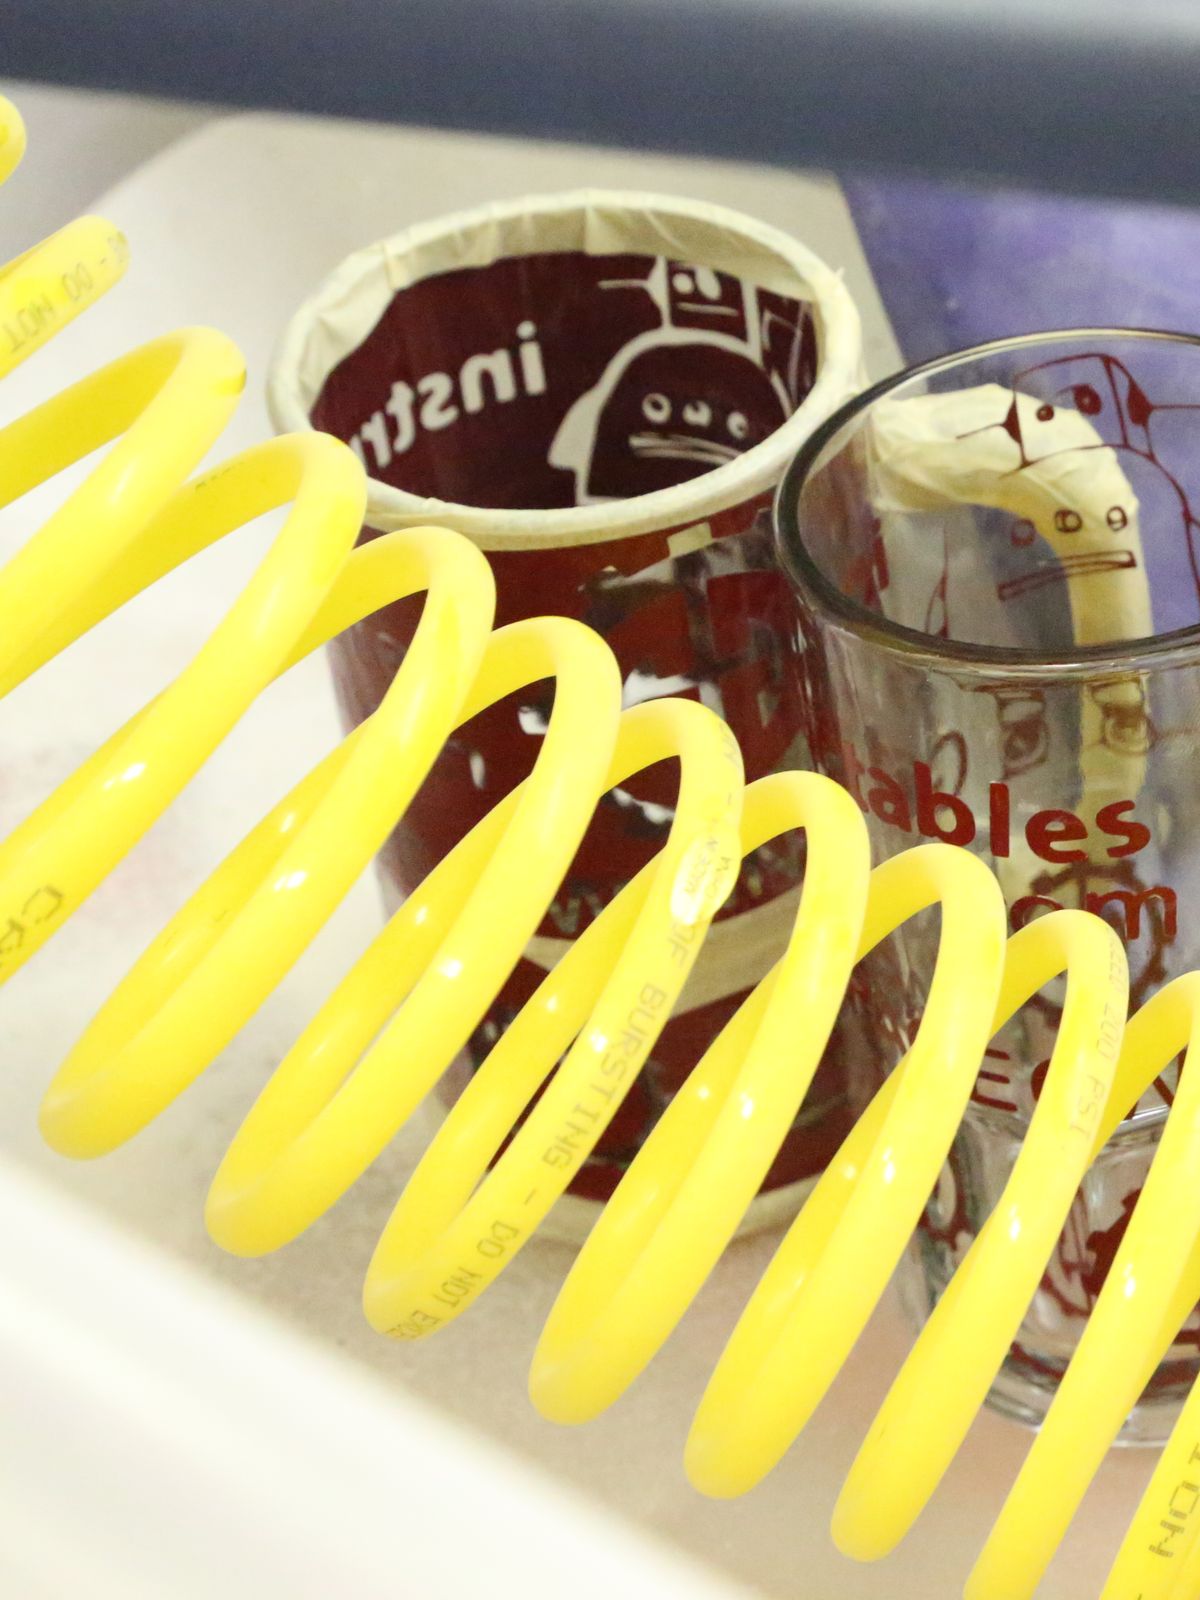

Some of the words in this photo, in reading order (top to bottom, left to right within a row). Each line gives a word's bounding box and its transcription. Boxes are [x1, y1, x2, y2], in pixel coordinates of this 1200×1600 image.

[541, 982, 668, 1170] BURSTING
[476, 1220, 519, 1258] DO
[432, 1266, 483, 1309] NOT
